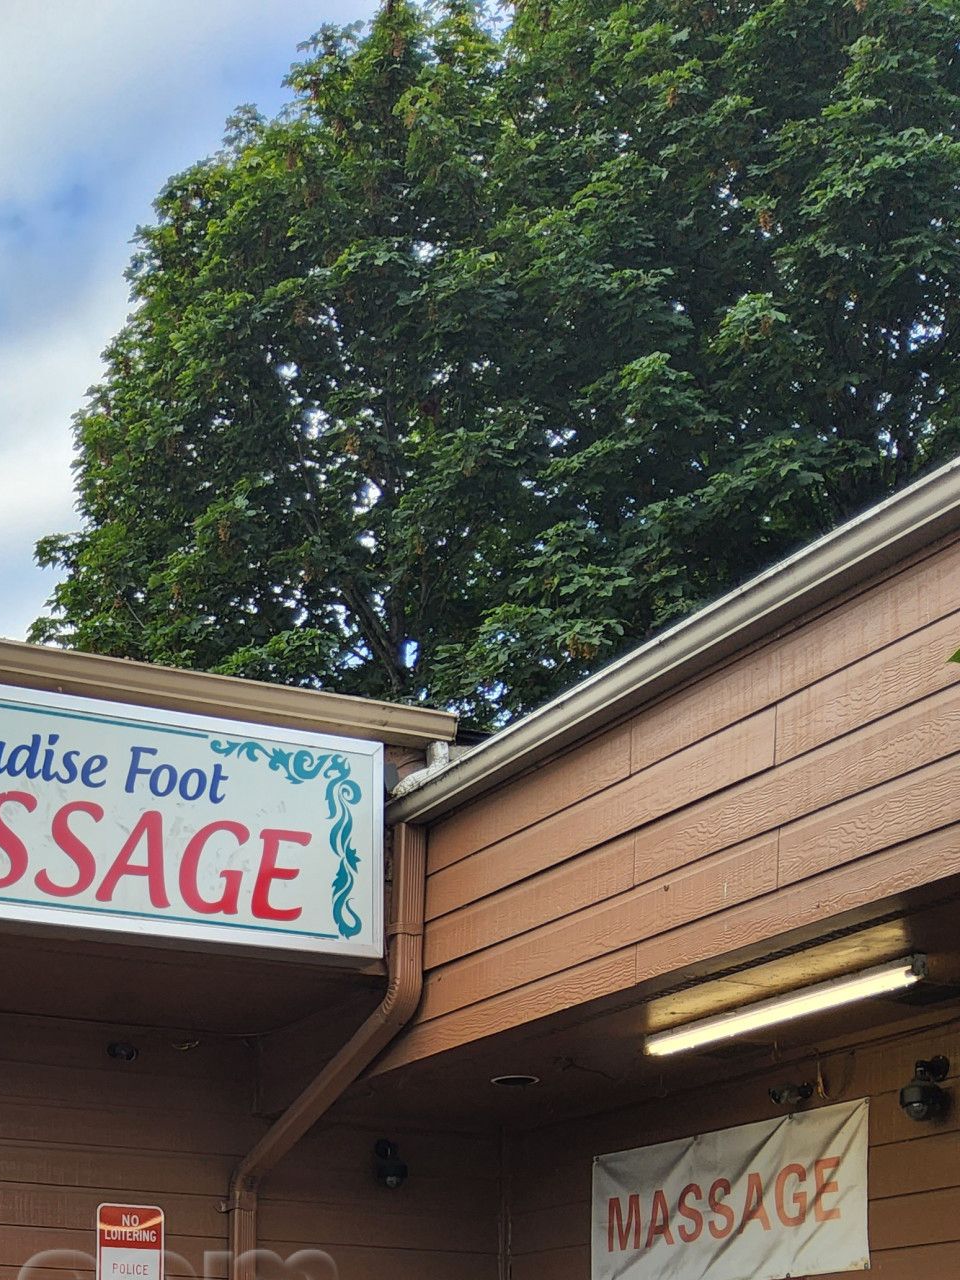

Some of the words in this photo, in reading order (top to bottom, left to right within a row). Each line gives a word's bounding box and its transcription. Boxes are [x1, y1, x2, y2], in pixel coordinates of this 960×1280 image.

[125, 747, 230, 804] Foot
[606, 1155, 843, 1253] MASSAGE
[121, 1214, 139, 1227] NO
[104, 1228, 157, 1243] LOITERING
[112, 1263, 149, 1276] POLICE
